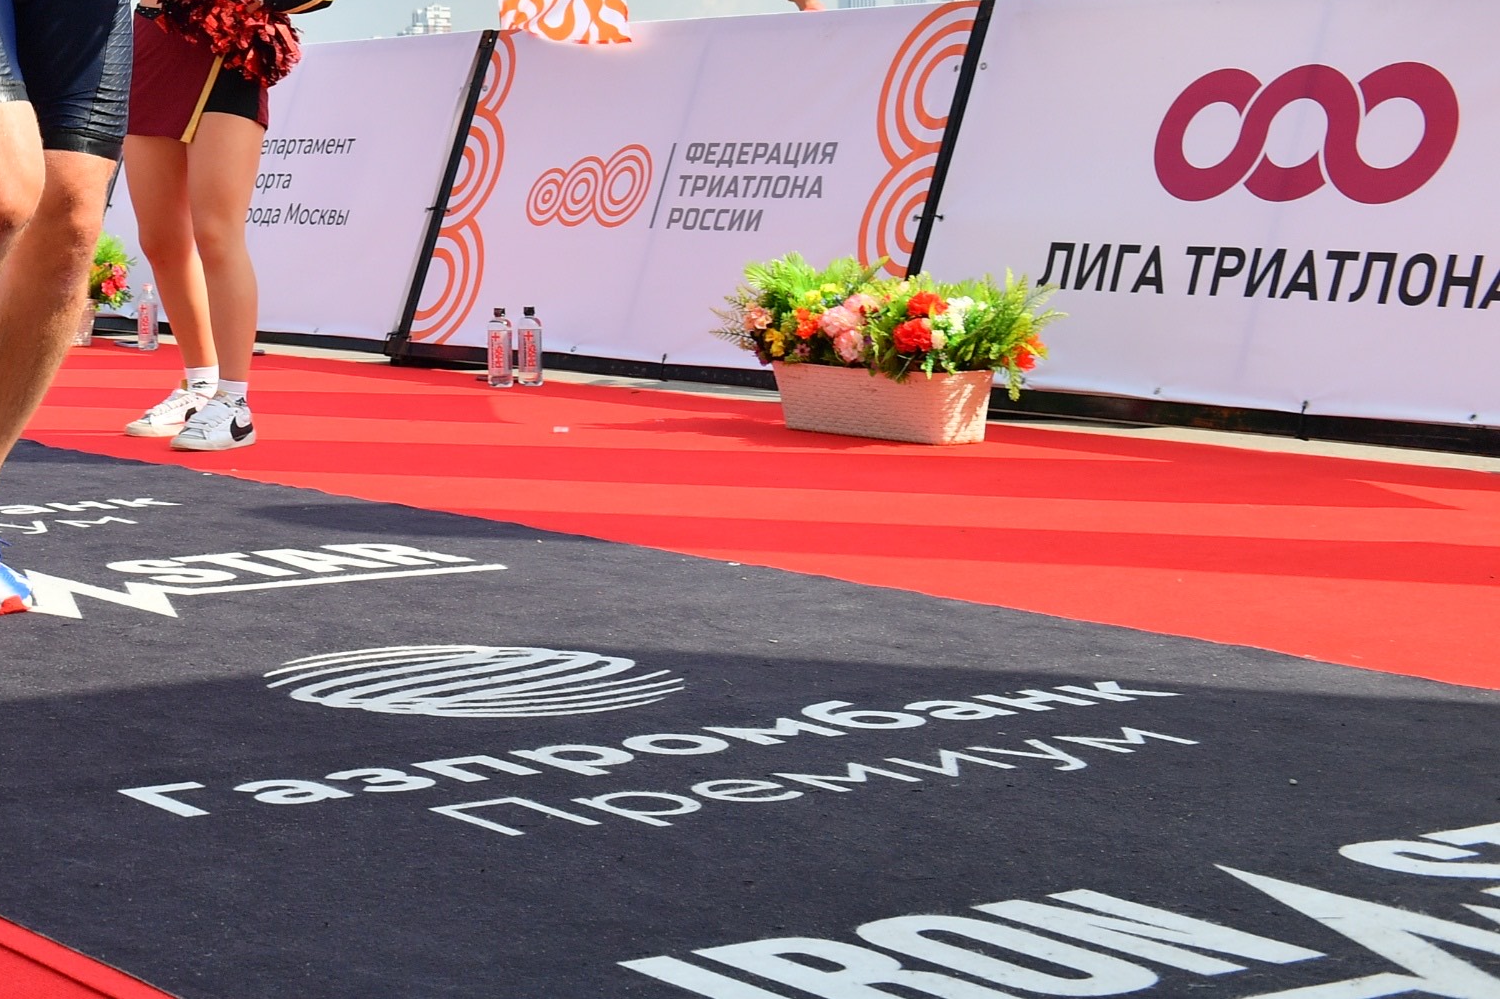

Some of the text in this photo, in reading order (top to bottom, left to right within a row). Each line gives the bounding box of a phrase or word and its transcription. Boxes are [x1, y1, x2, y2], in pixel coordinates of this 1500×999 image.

[261, 138, 356, 160] епартамент
[684, 140, 838, 165] ФЕДЕРАЦИЯ
[255, 173, 292, 194] орта
[677, 174, 823, 200] ТРИАТЛОНА
[283, 203, 350, 226] Москвы
[666, 207, 763, 232] РОССИИ
[1036, 241, 1164, 295] ЛИГА
[106, 541, 476, 584] STAR
[118, 680, 1186, 818] Газпромбанк
[430, 726, 1199, 837] Премиум
